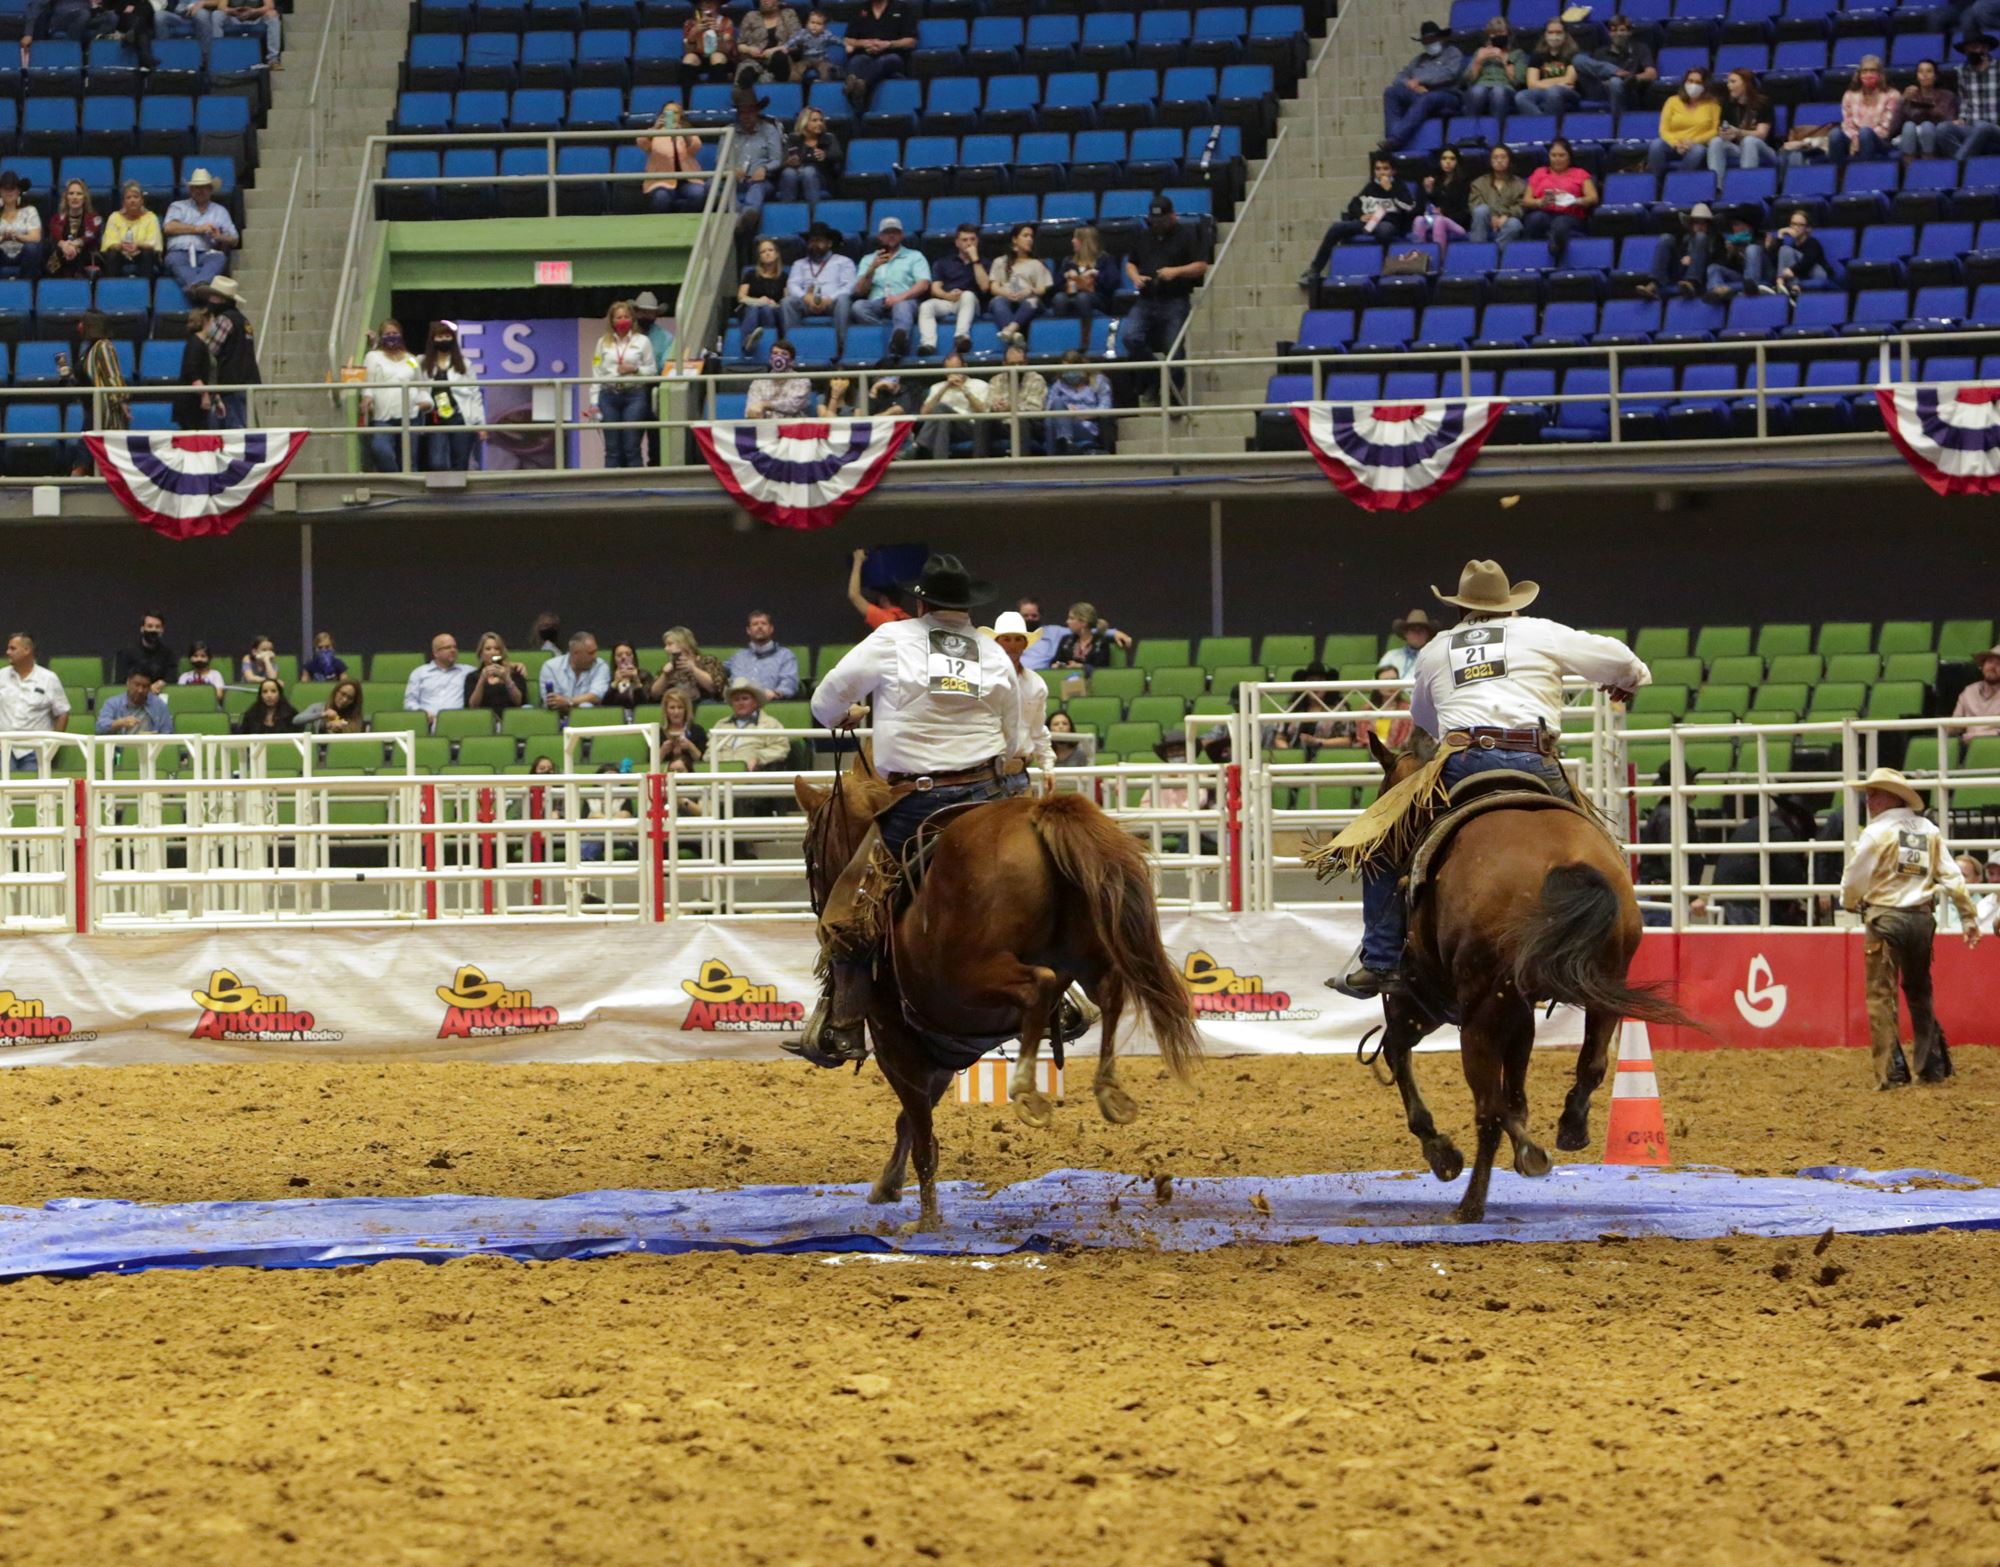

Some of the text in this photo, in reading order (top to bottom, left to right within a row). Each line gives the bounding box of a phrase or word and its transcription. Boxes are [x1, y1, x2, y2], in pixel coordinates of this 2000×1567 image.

[1465, 646, 1486, 664] 21
[946, 659, 966, 678] 12
[1464, 663, 1494, 680] 2021
[1906, 850, 1920, 863] 20
[192, 968, 287, 1013] San
[436, 964, 532, 1008] San
[681, 958, 777, 1003] San
[0, 990, 44, 1018] an
[1191, 991, 1291, 1014] ntonio
[1200, 1010, 1233, 1020] Stock
[1235, 1010, 1266, 1020] Show
[1279, 1008, 1319, 1020] Rodeo
[0, 1015, 72, 1038] onio
[189, 1010, 315, 1040] Antonio
[436, 1005, 559, 1039] Antonio
[680, 1000, 805, 1031] Antonio
[714, 1020, 748, 1031] Stock
[749, 1020, 781, 1031] Show
[782, 1020, 791, 1031] &
[223, 1029, 343, 1041] Stock Show & Rodeo
[469, 1026, 502, 1037] Stock
